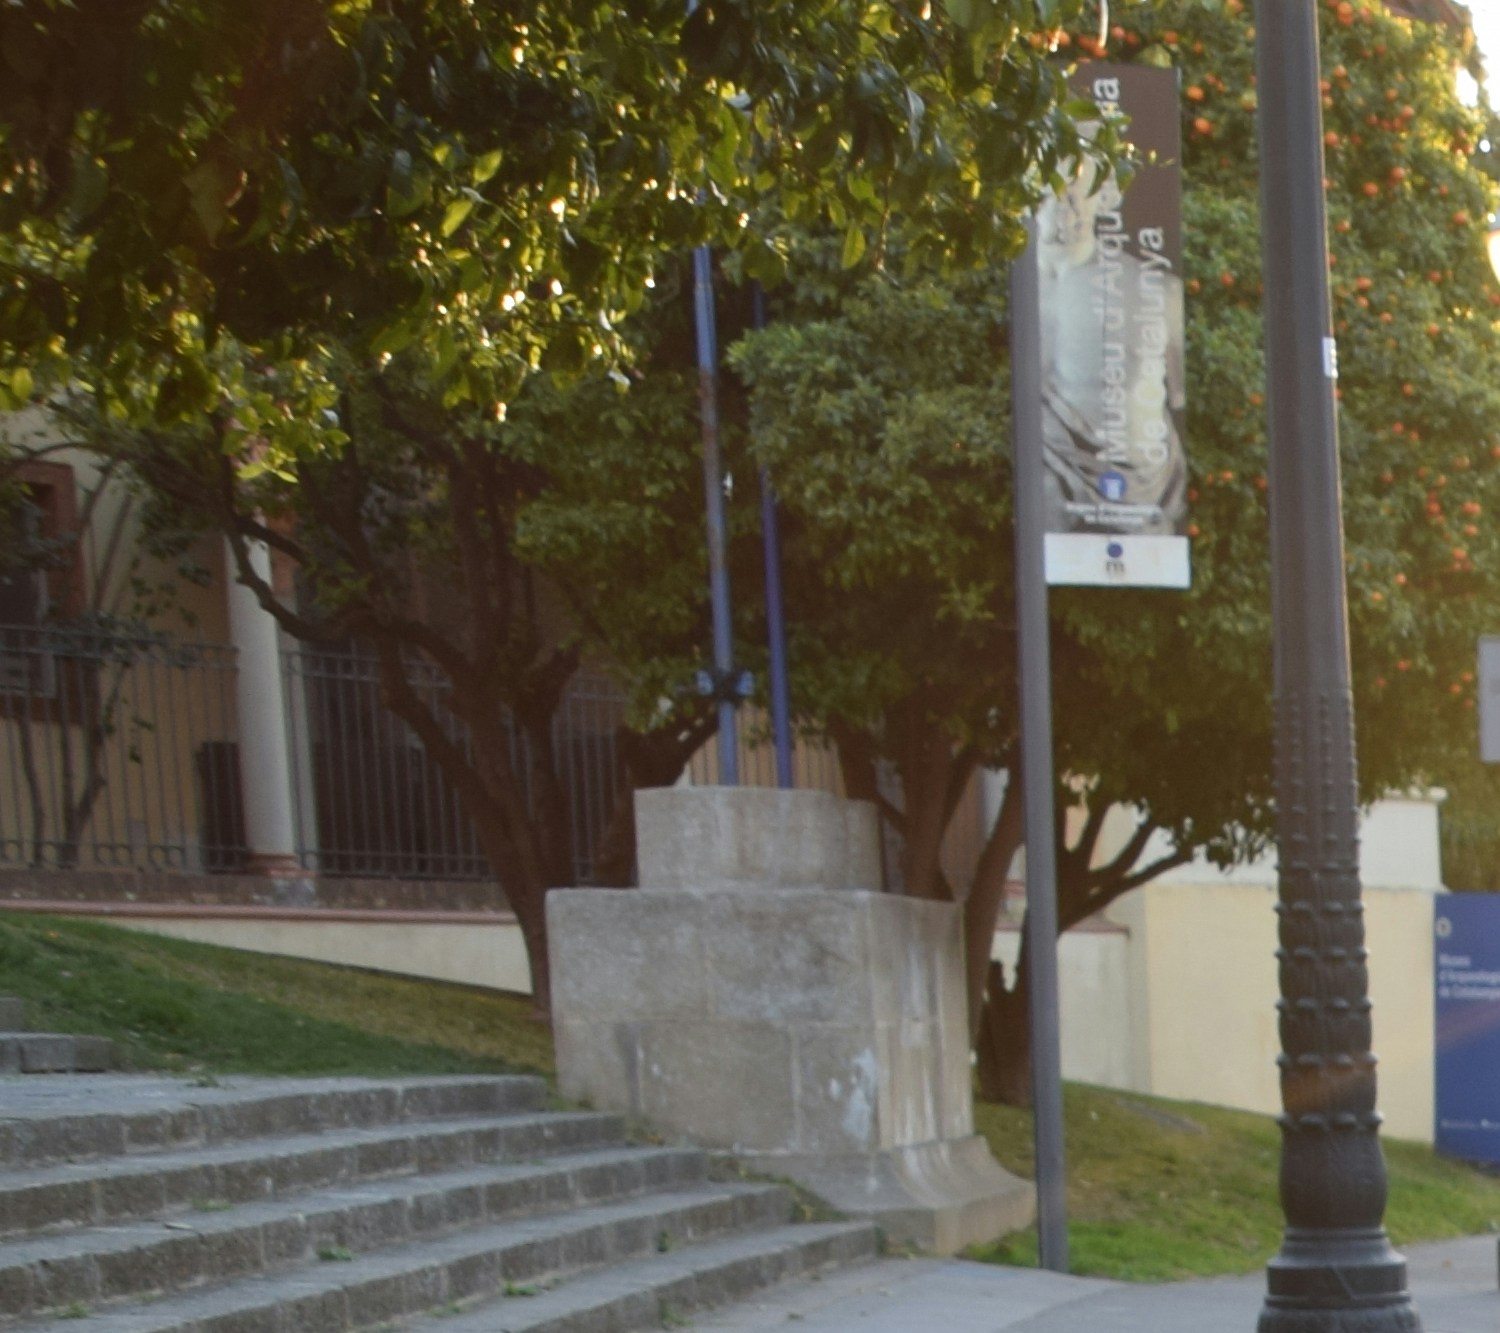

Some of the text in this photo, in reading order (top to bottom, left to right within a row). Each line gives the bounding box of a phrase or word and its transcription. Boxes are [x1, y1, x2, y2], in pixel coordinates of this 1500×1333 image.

[1095, 343, 1127, 462] Museu
[1136, 226, 1173, 466] de Catalunya
